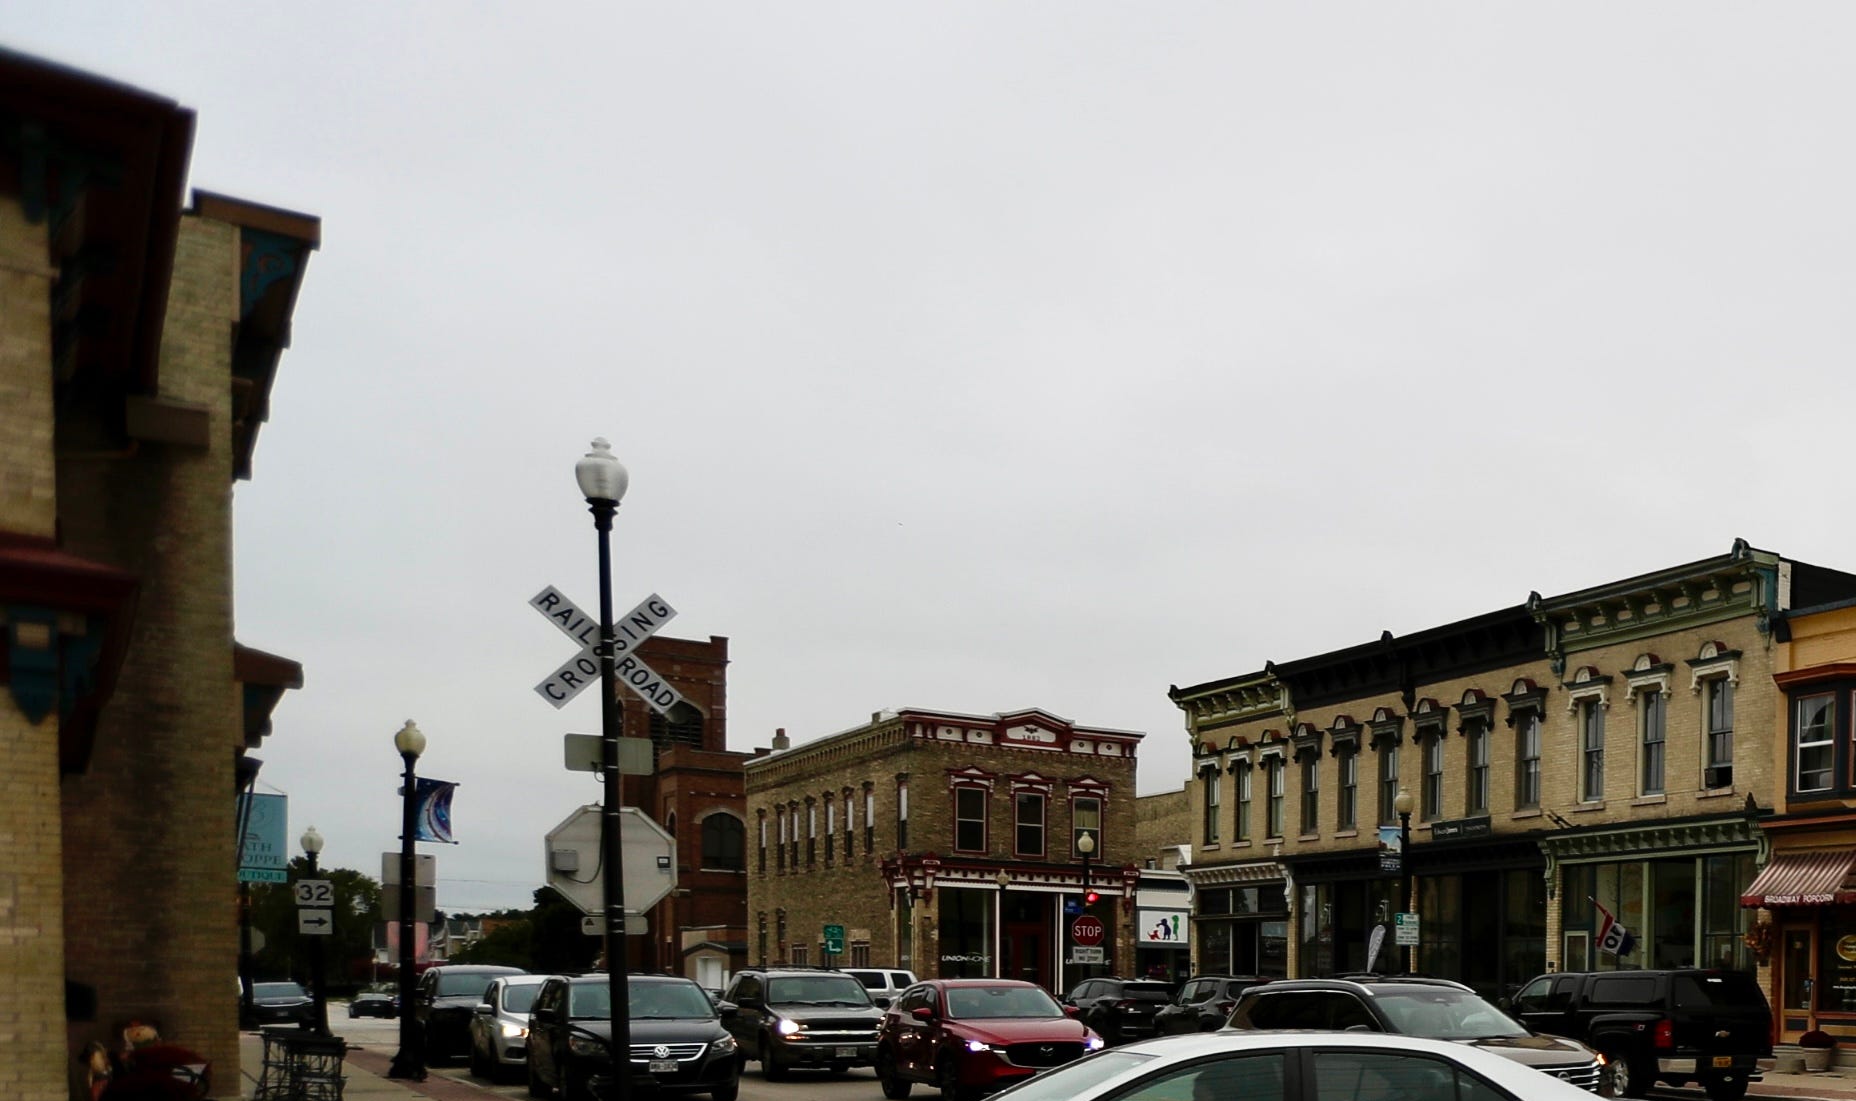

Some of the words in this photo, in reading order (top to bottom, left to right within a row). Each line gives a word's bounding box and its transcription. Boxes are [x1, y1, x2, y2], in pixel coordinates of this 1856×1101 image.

[300, 884, 330, 901] 32
[1764, 895, 1800, 904] BROADWAY
[1802, 893, 1834, 903] POPCORN
[1074, 925, 1102, 937] STOP
